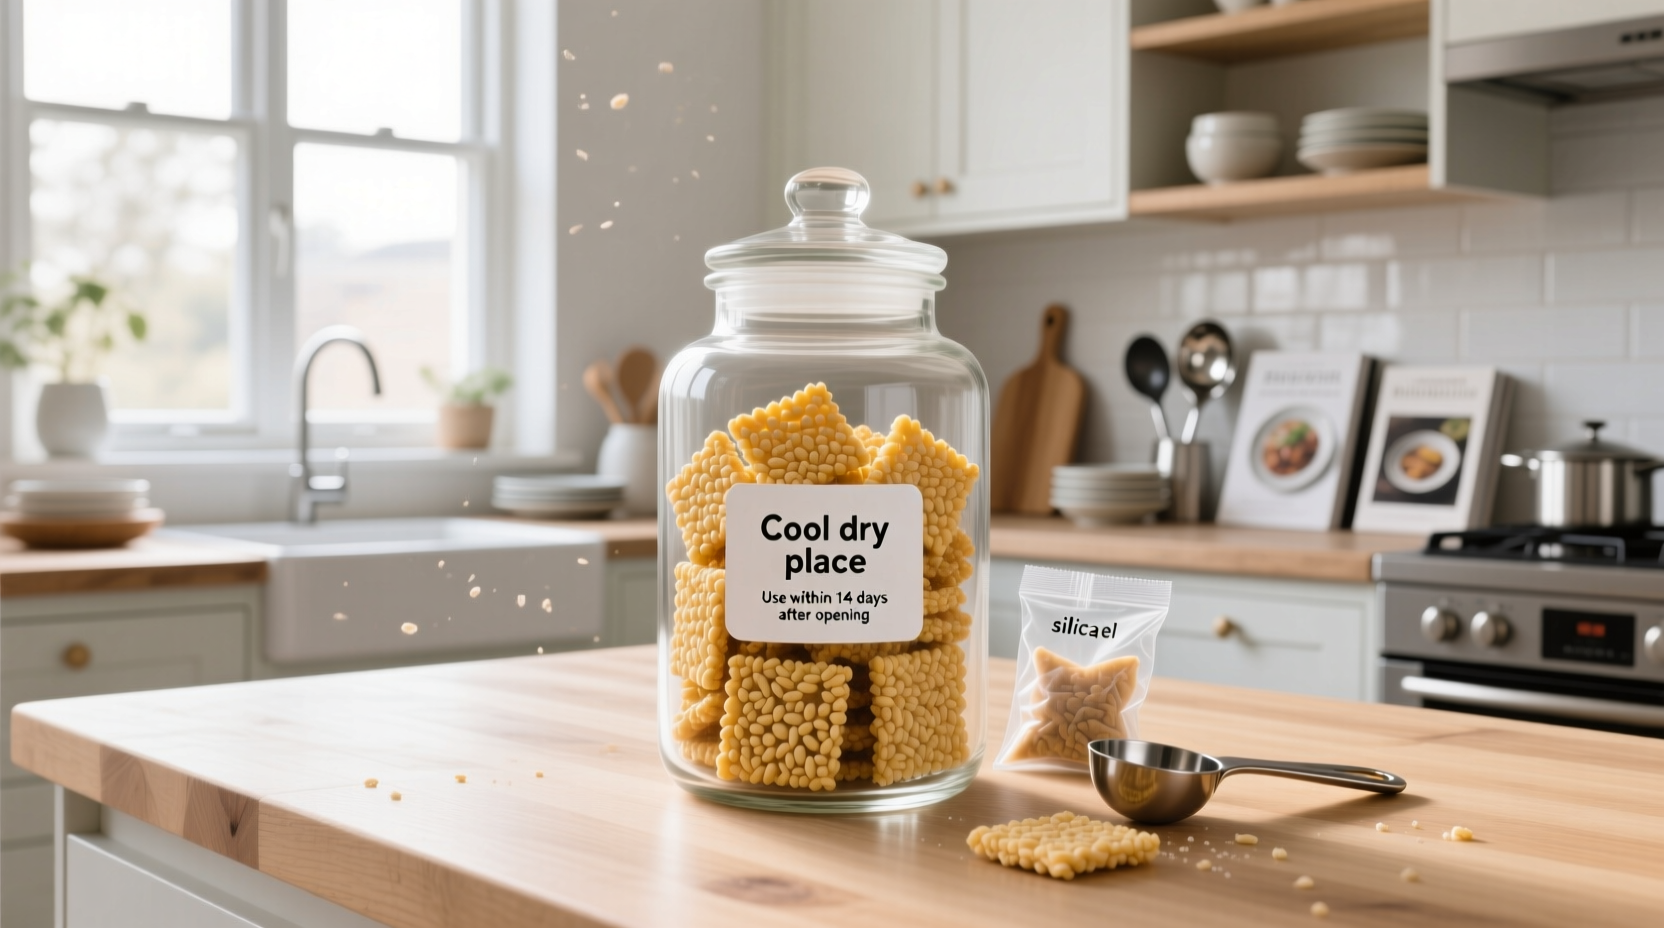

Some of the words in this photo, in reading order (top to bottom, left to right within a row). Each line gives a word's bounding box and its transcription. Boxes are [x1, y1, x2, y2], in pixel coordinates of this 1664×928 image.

[761, 513, 829, 541] Cool
[839, 515, 889, 549] dry
[785, 547, 867, 580] place
[762, 590, 787, 604] Use
[790, 590, 832, 604] within
[836, 591, 853, 604] 14
[857, 590, 888, 607] days
[778, 608, 811, 621] after
[815, 608, 870, 625] opening
